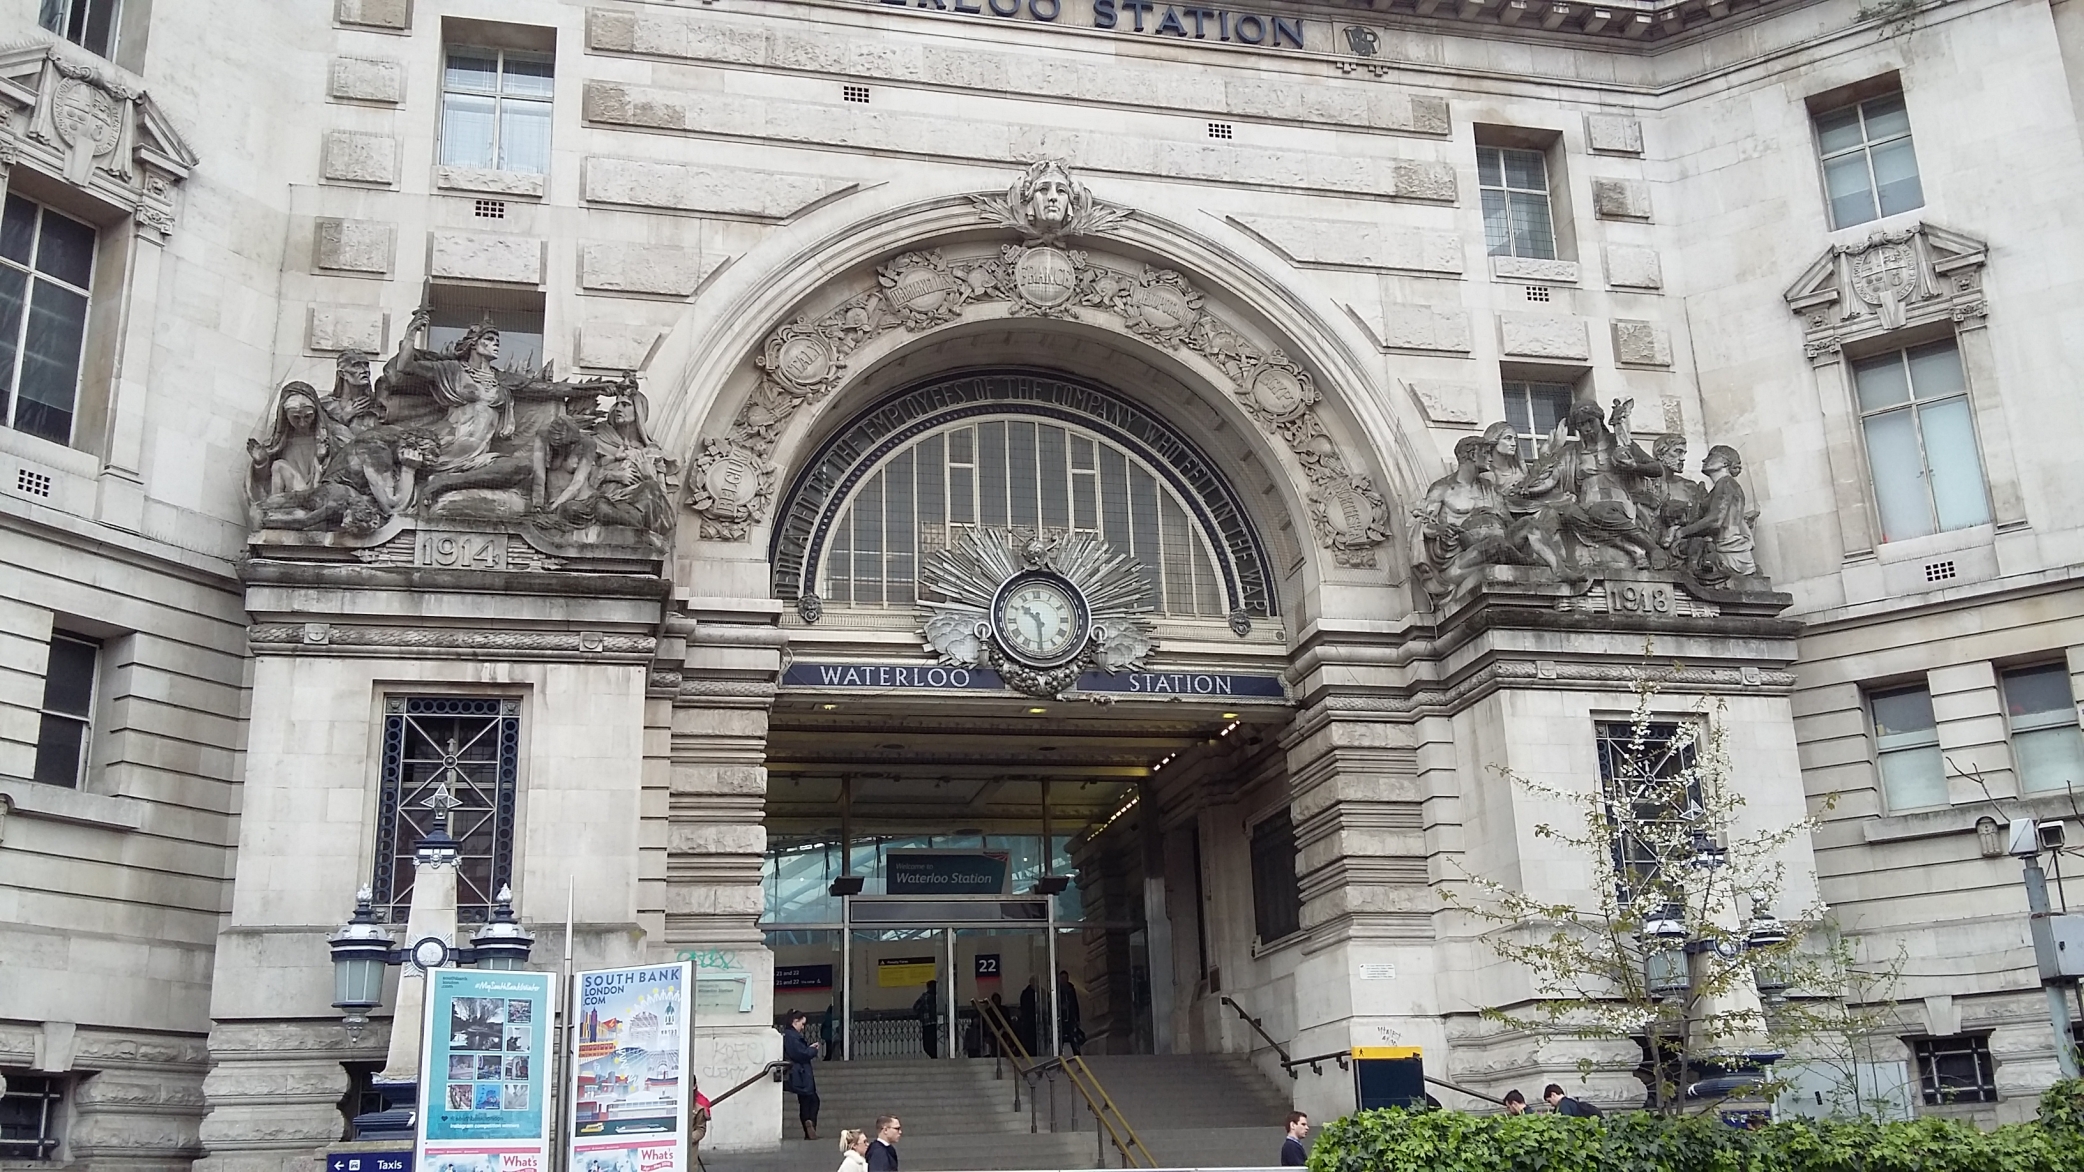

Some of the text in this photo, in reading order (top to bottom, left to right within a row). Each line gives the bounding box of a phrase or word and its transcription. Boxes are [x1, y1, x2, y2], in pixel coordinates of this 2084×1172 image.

[1093, 0, 1303, 49] STATION
[1019, 266, 1073, 291] FRANCE
[786, 341, 823, 379] ITALY
[1258, 372, 1297, 409] EGYPT
[717, 448, 752, 512] BELGIUM
[824, 433, 862, 475] THE
[862, 382, 967, 444] EMPLOYEES
[973, 377, 994, 401] OF
[1004, 377, 1044, 401] THE
[1052, 383, 1140, 430] COMPANY
[1143, 421, 1183, 462] WHO
[1178, 455, 1217, 501] FELL
[1209, 498, 1238, 523] IN
[1225, 516, 1257, 561] THE
[1241, 566, 1267, 612] WAR
[422, 537, 500, 568] 1914
[1610, 586, 1668, 613] 1918
[820, 666, 1232, 694] WATERLOO STATION
[896, 872, 992, 884] Waterloo Station
[585, 968, 680, 987] SOUTH BANK
[979, 960, 996, 973] 22
[583, 996, 606, 1006] .COM
[584, 985, 625, 997] LONDON
[377, 1160, 403, 1170] Taxis
[503, 1155, 538, 1167] What's
[641, 1148, 674, 1160] What's
